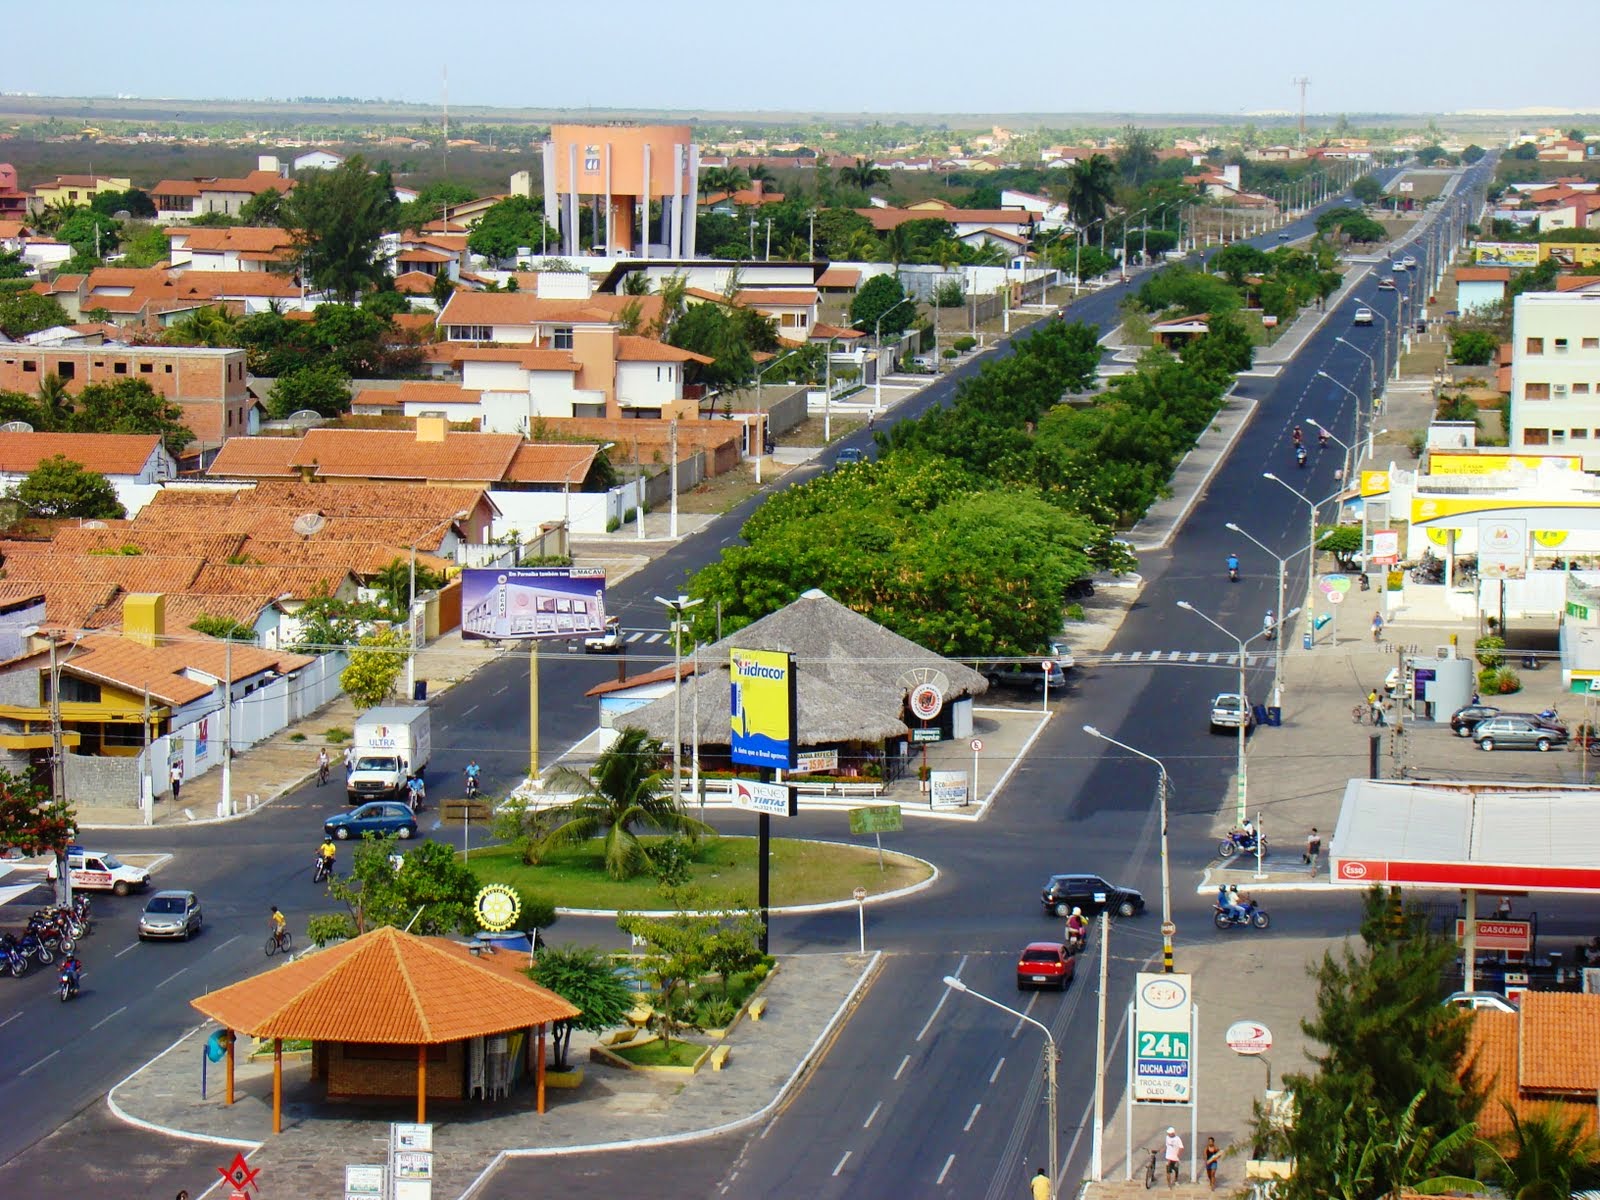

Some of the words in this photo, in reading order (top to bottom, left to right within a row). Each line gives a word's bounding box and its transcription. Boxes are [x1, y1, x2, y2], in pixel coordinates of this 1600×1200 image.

[738, 661, 785, 680] Hidracor
[369, 738, 396, 746] ULTRA
[753, 786, 786, 799] NEVES
[753, 796, 786, 807] TINTAS
[1480, 925, 1524, 935] GASOLINA
[1139, 1063, 1163, 1074] DUCHA
[1164, 1064, 1182, 1075] JATO
[1139, 1079, 1161, 1087] TROCA
